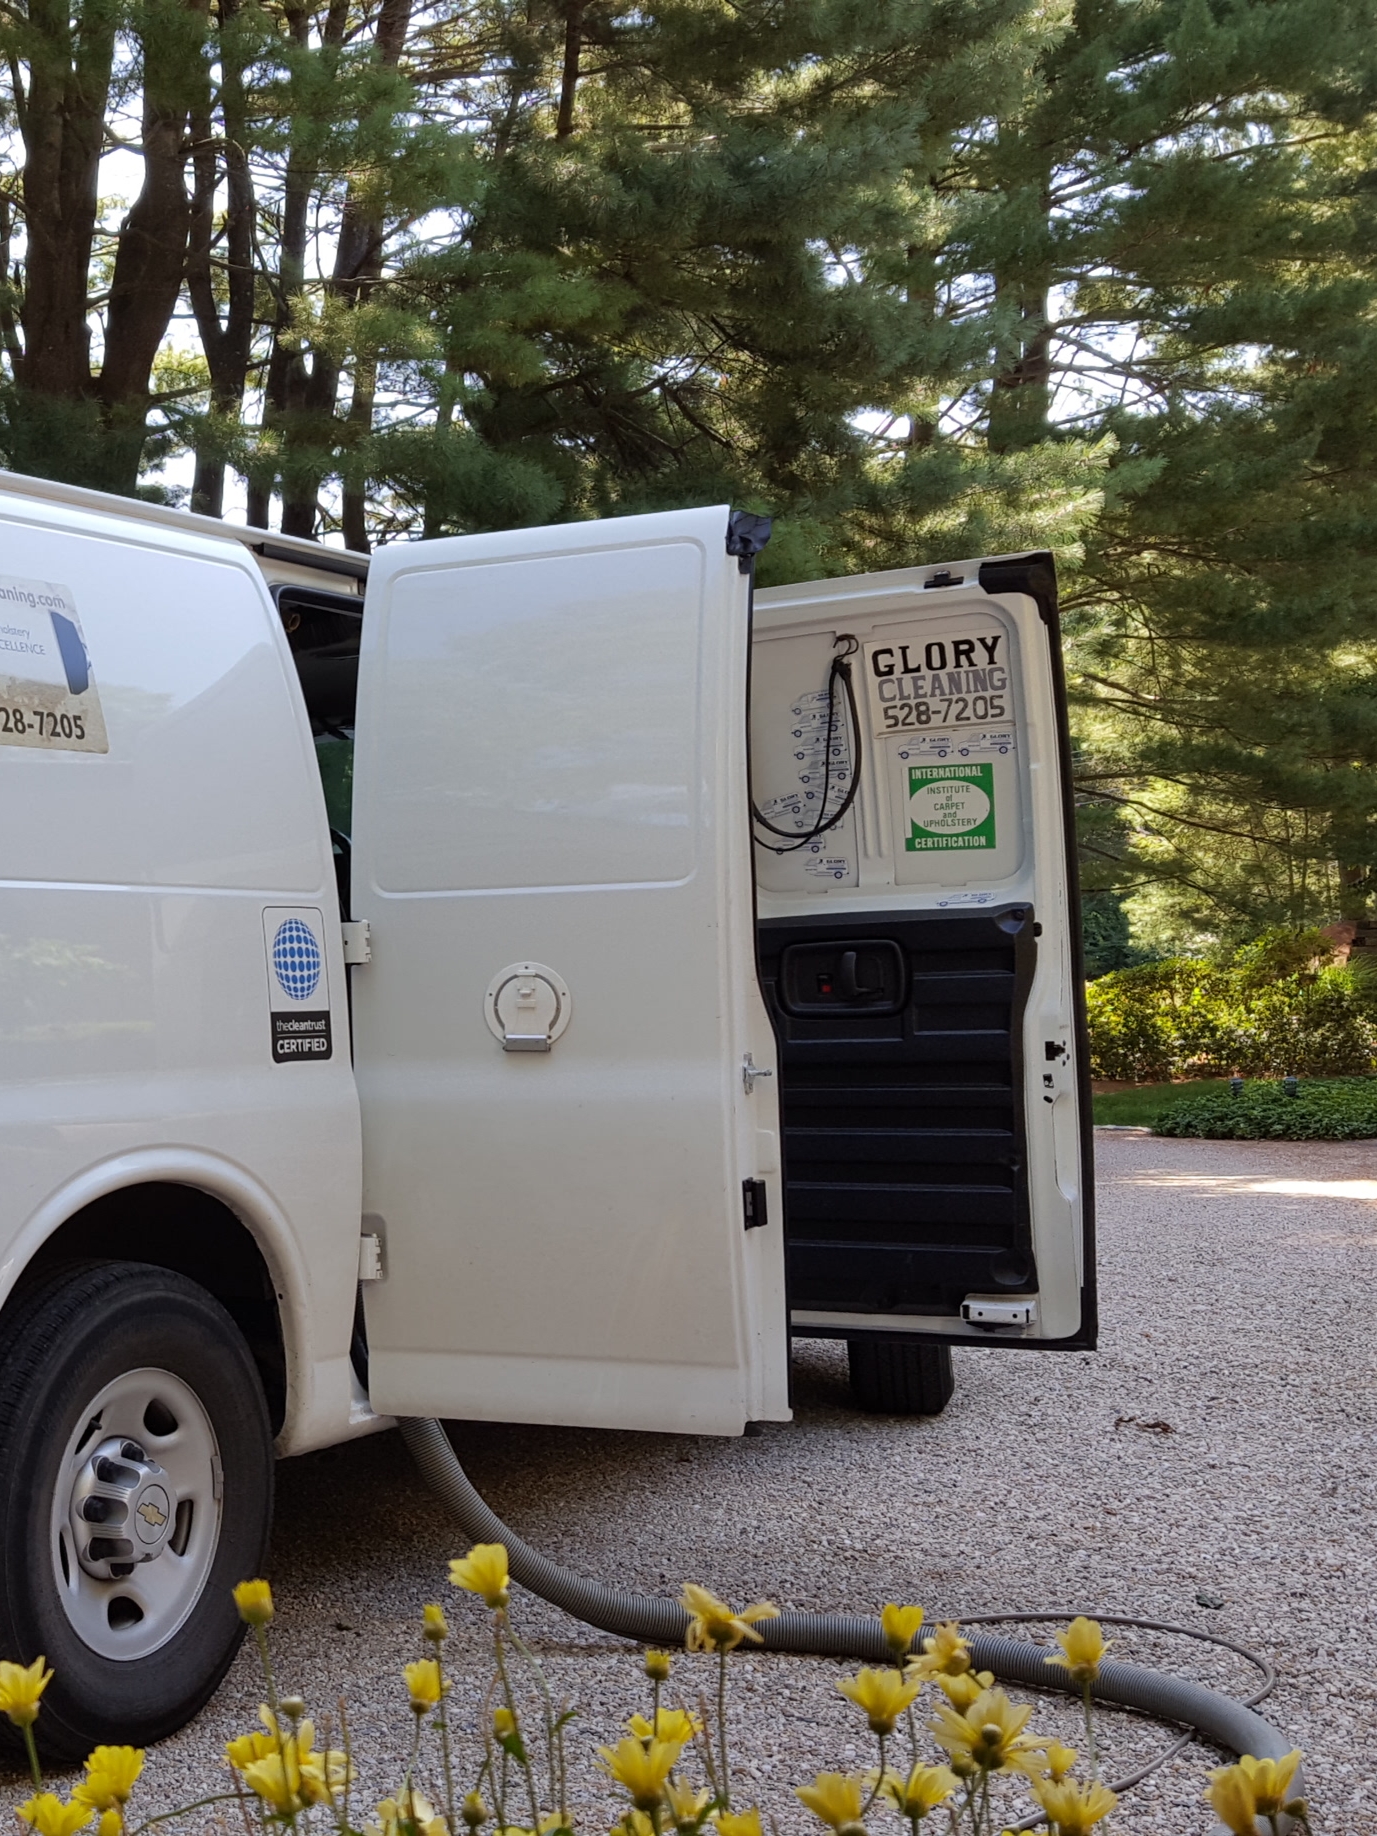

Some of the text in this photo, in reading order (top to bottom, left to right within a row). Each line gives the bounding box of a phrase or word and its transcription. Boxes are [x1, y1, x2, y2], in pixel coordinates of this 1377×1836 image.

[872, 635, 1002, 677] GLORY
[877, 666, 1007, 703] CLEANING
[883, 694, 1006, 729] 528-7205
[912, 765, 983, 780] INTERNATIONAL
[926, 785, 971, 795] INSTITUTE
[945, 794, 953, 802] of
[933, 802, 965, 811] CARPET
[923, 818, 978, 828] UPHOLSTERY
[915, 836, 986, 848] CERTIFICATION
[276, 1019, 326, 1032] thecleantrust
[277, 1038, 328, 1054] CERTIFIED
